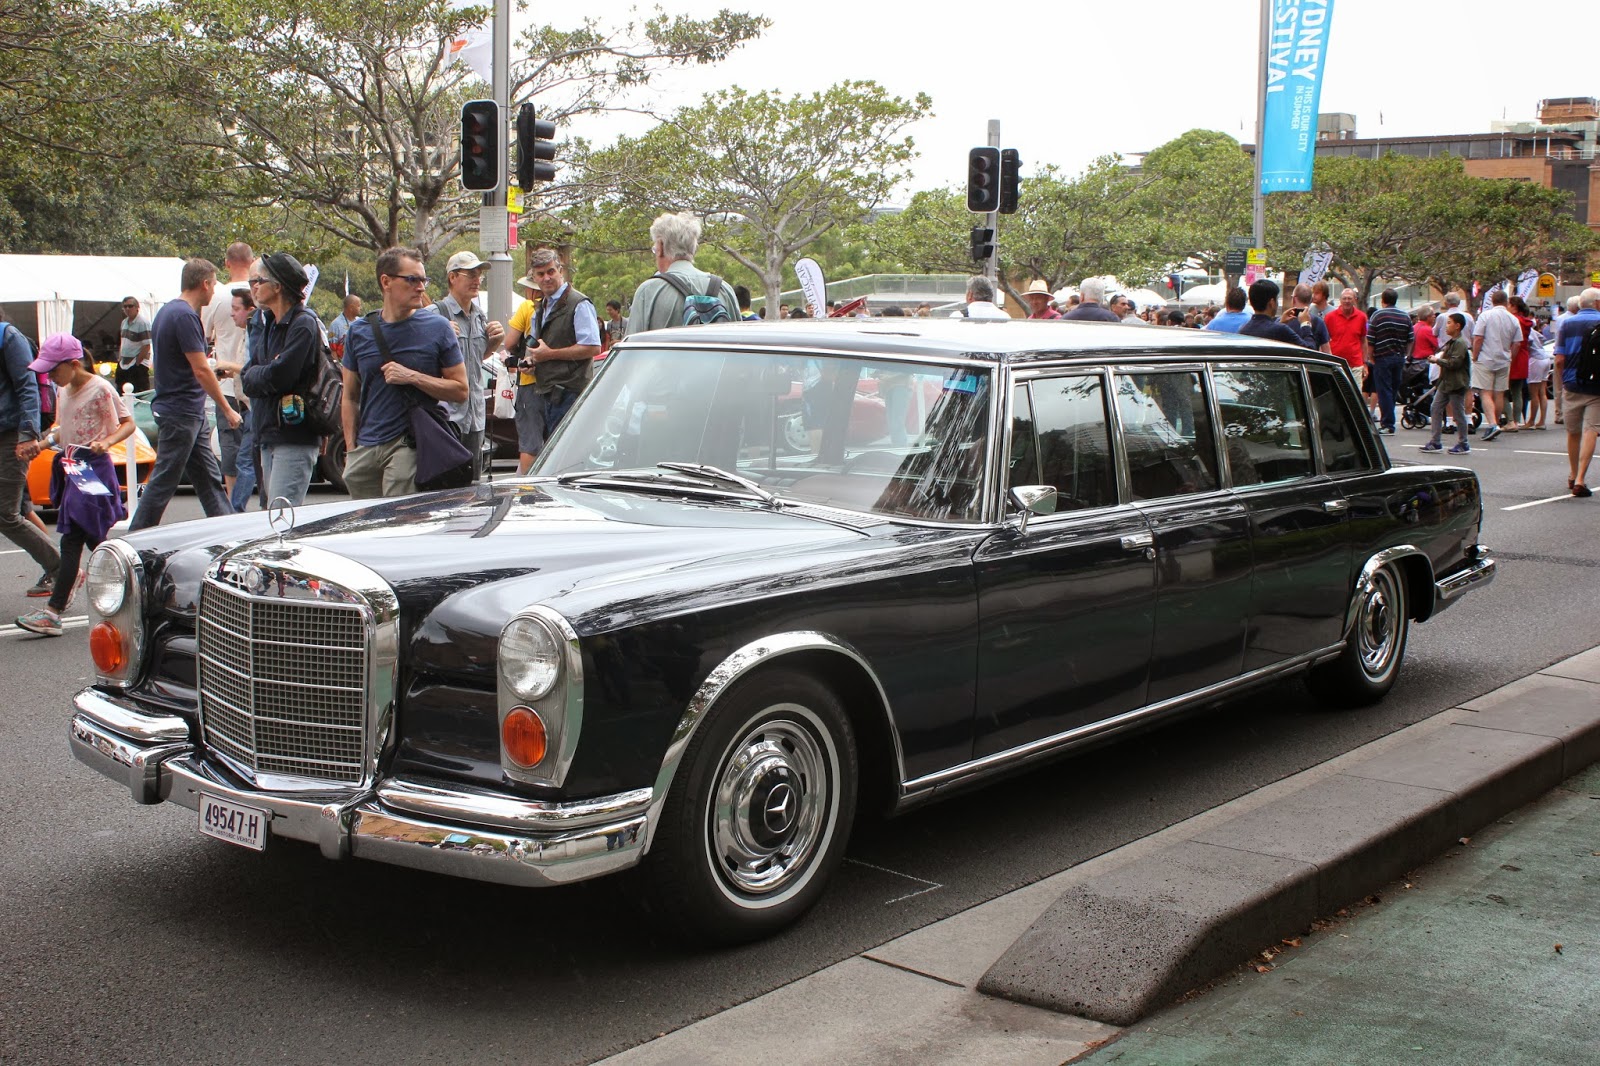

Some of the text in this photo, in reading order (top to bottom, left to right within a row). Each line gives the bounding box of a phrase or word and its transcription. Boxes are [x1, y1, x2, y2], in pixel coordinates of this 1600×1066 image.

[1303, 85, 1314, 104] THIS
[1291, 85, 1304, 130] IN SUMMER
[1300, 115, 1311, 131] OUR
[1297, 134, 1309, 152] CITY
[1308, 251, 1327, 283] RCAR
[797, 266, 821, 316] SUPERCAR
[216, 829, 237, 840] HISTORIC
[237, 835, 256, 845] VEHICLE
